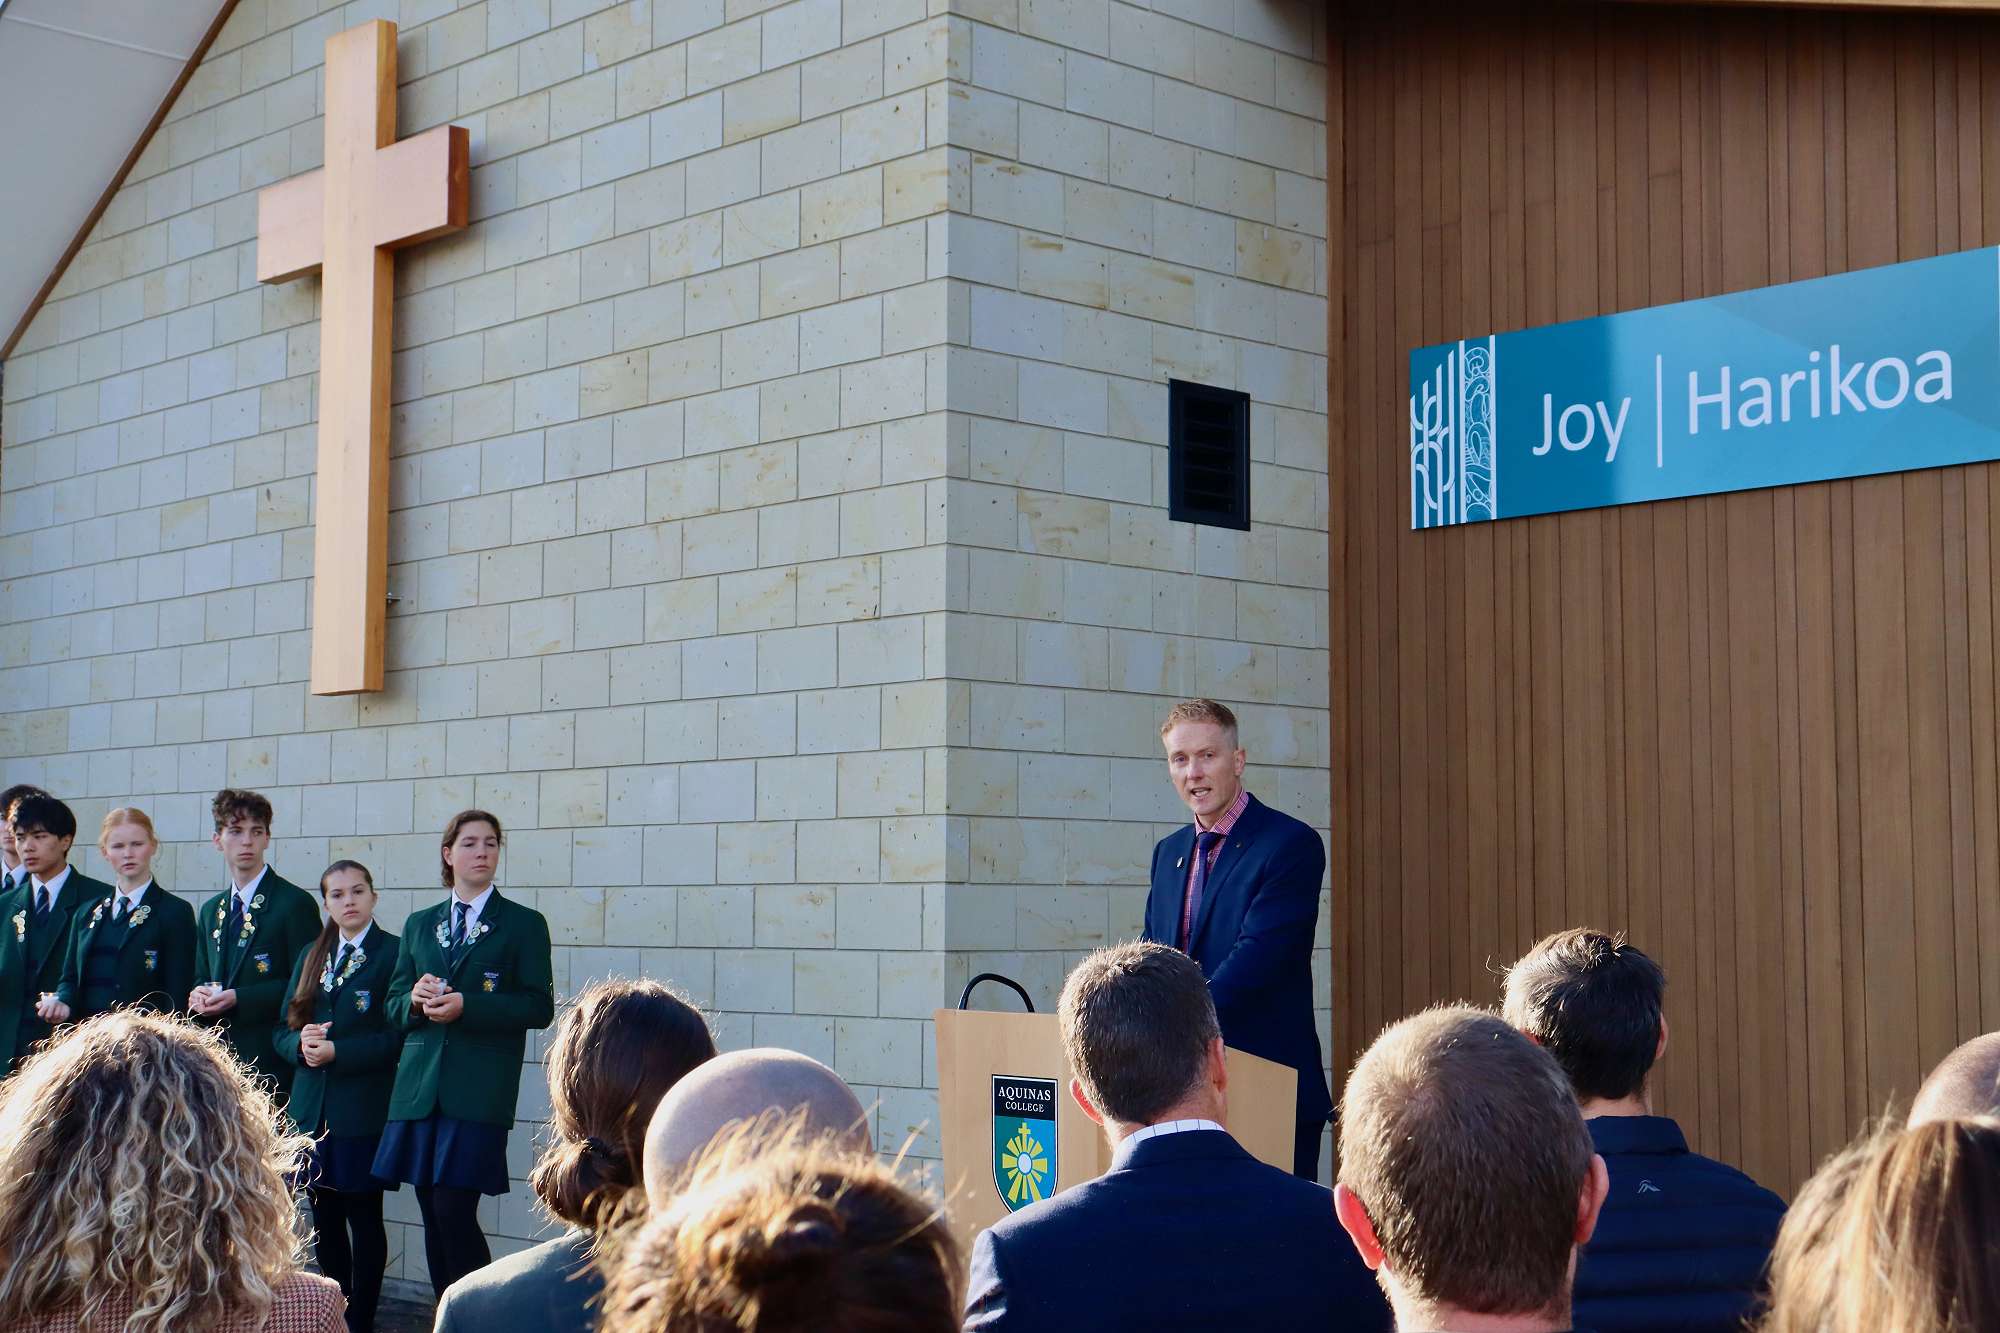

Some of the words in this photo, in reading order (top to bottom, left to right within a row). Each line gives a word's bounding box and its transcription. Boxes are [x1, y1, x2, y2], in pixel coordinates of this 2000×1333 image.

[1532, 393, 1632, 463] Joy
[1688, 344, 1953, 435] Harikoa
[998, 1086, 1051, 1101] AQUINAS
[1005, 1101, 1045, 1113] COLLEGE
